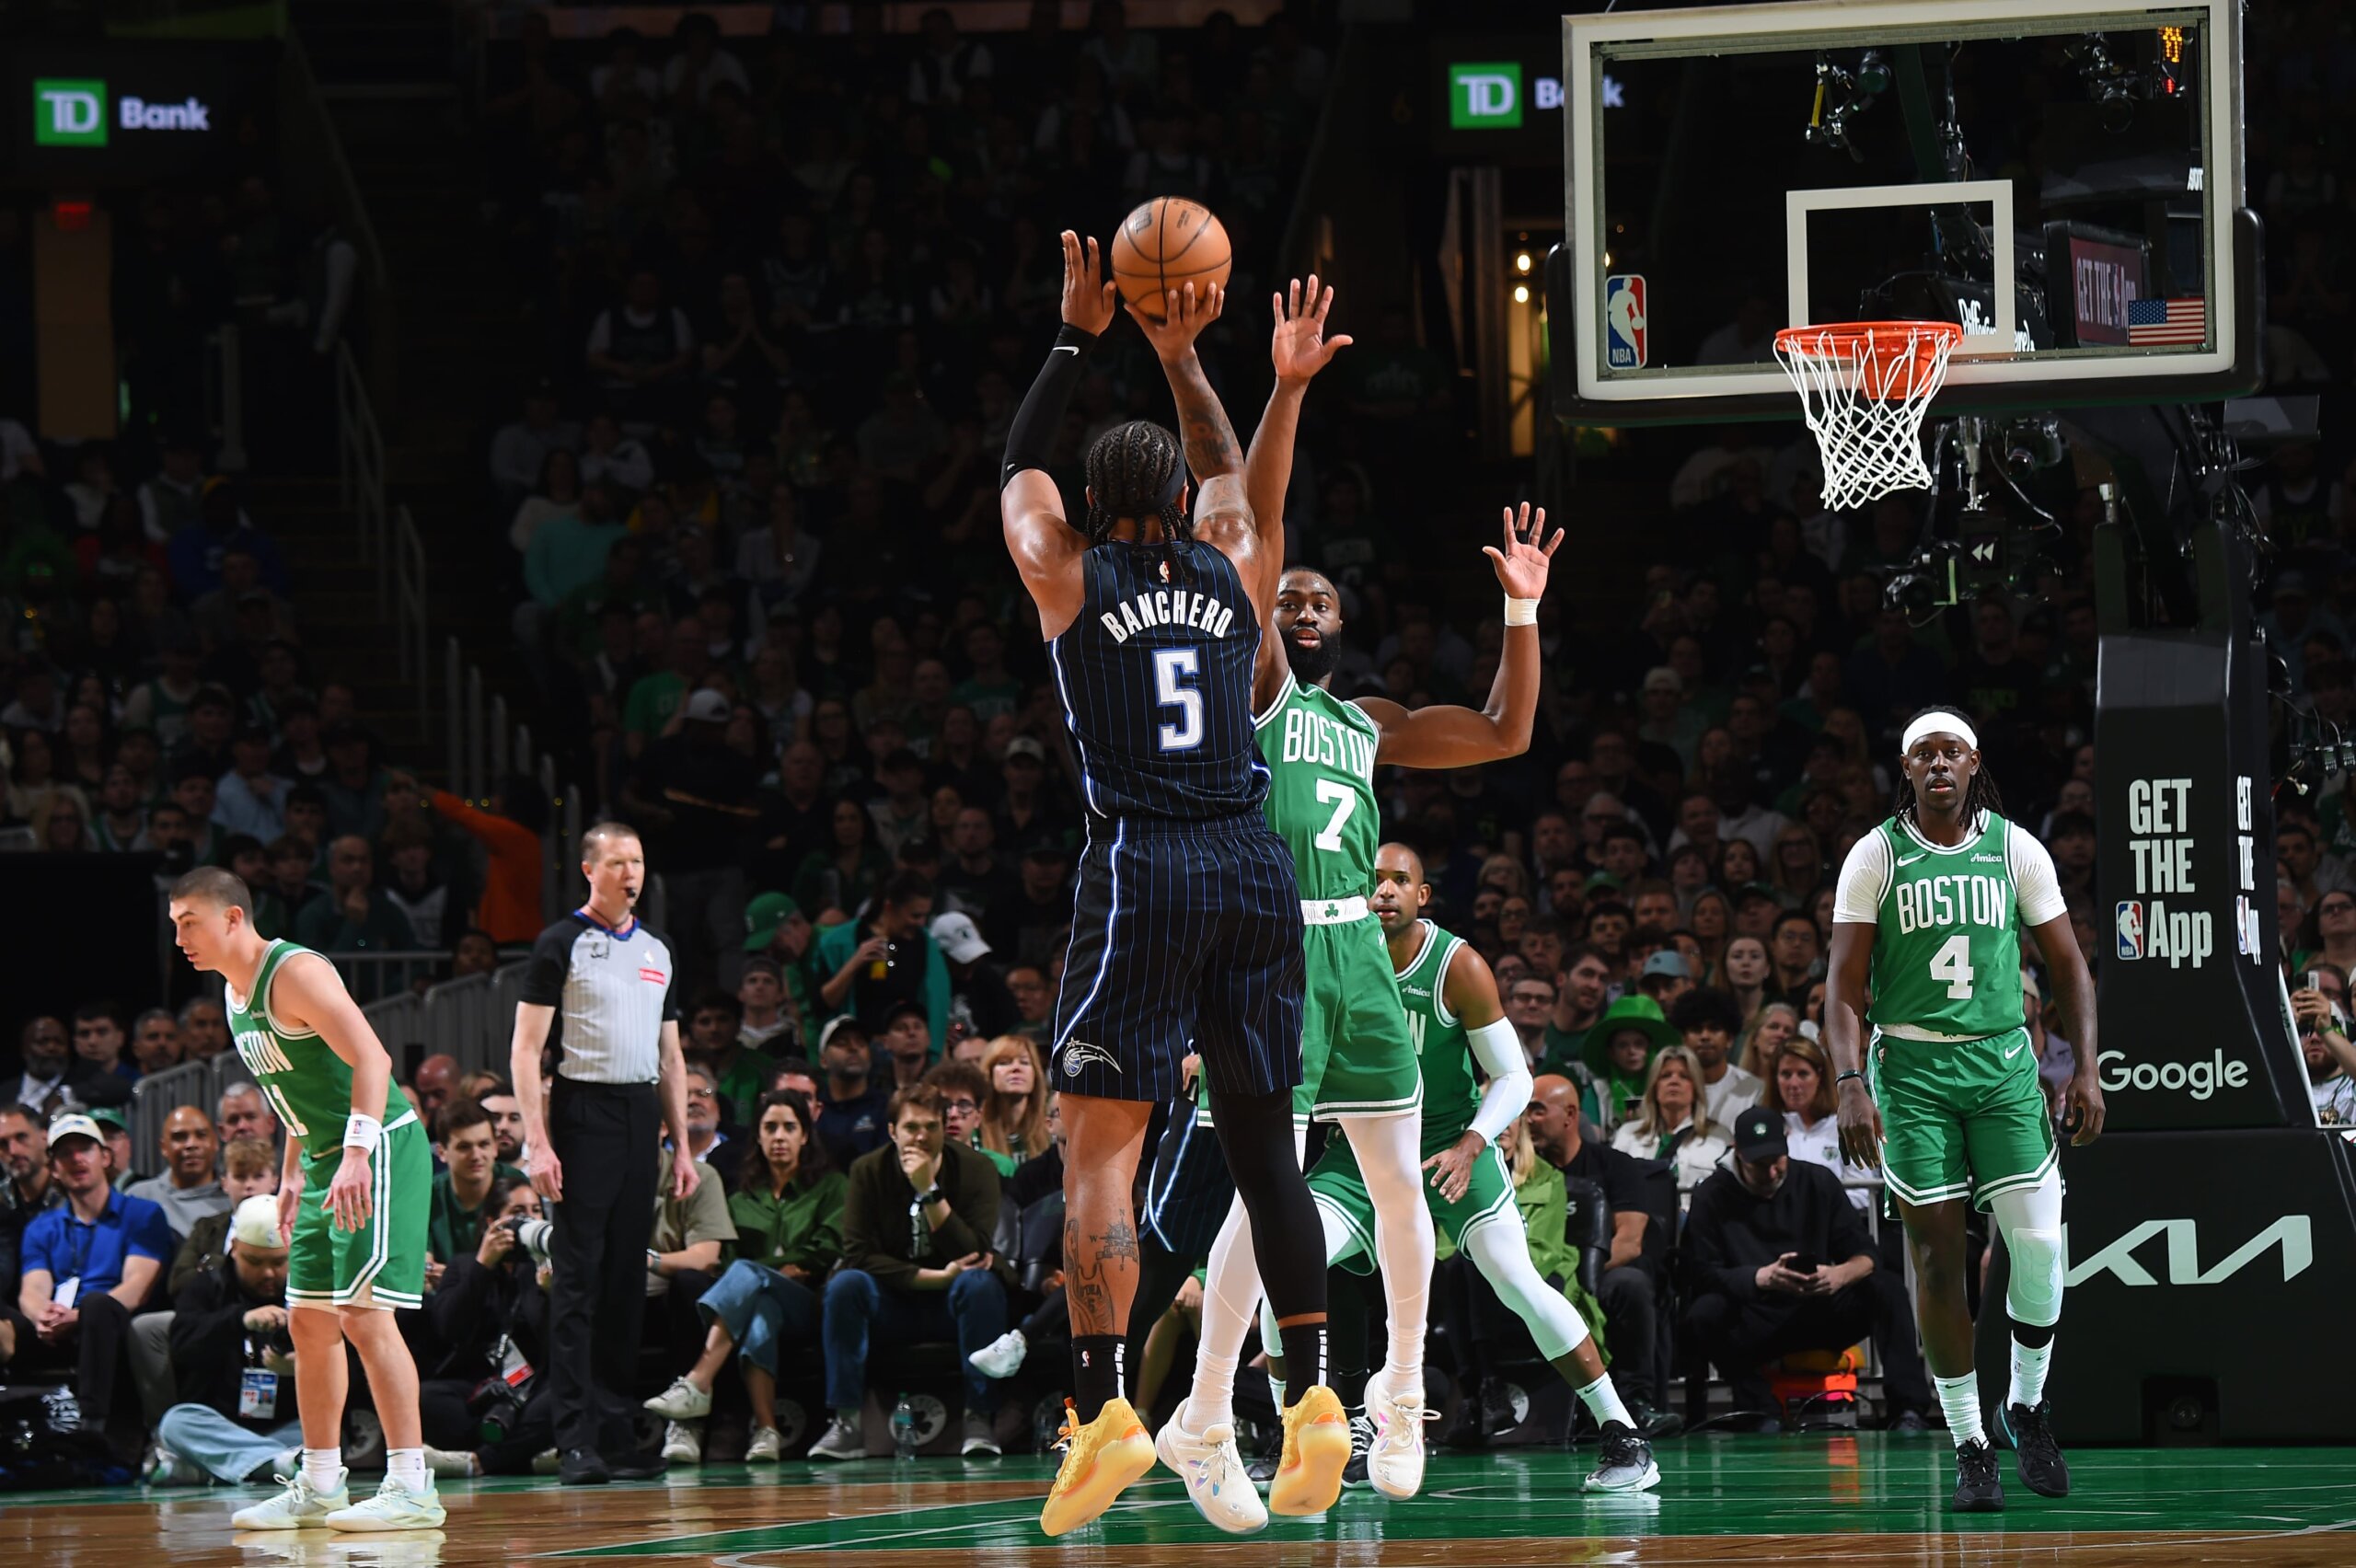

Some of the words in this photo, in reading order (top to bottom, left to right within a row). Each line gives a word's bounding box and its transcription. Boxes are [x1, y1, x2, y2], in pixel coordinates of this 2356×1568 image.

[40, 90, 100, 134] TD
[119, 96, 211, 131] Bank
[1457, 75, 1515, 116] TD
[1534, 76, 1625, 109] Bk
[2076, 257, 2094, 322] GET
[2095, 260, 2113, 327] THE
[1612, 348, 1632, 363] NBA
[1101, 590, 1233, 644] BANCHERO
[1152, 647, 1204, 752] 5
[1283, 708, 1374, 790] BOSTON
[1316, 778, 1357, 852] 7
[2129, 778, 2192, 835] GET
[1970, 853, 2003, 863] Amica
[2129, 838, 2196, 894] THE
[1896, 875, 2006, 935] BOSTON
[2147, 901, 2212, 969] App
[1402, 985, 1431, 997] Amica
[1929, 935, 1974, 999] 4
[2097, 1048, 2248, 1101] Google
[2061, 1215, 2313, 1287] KIA
